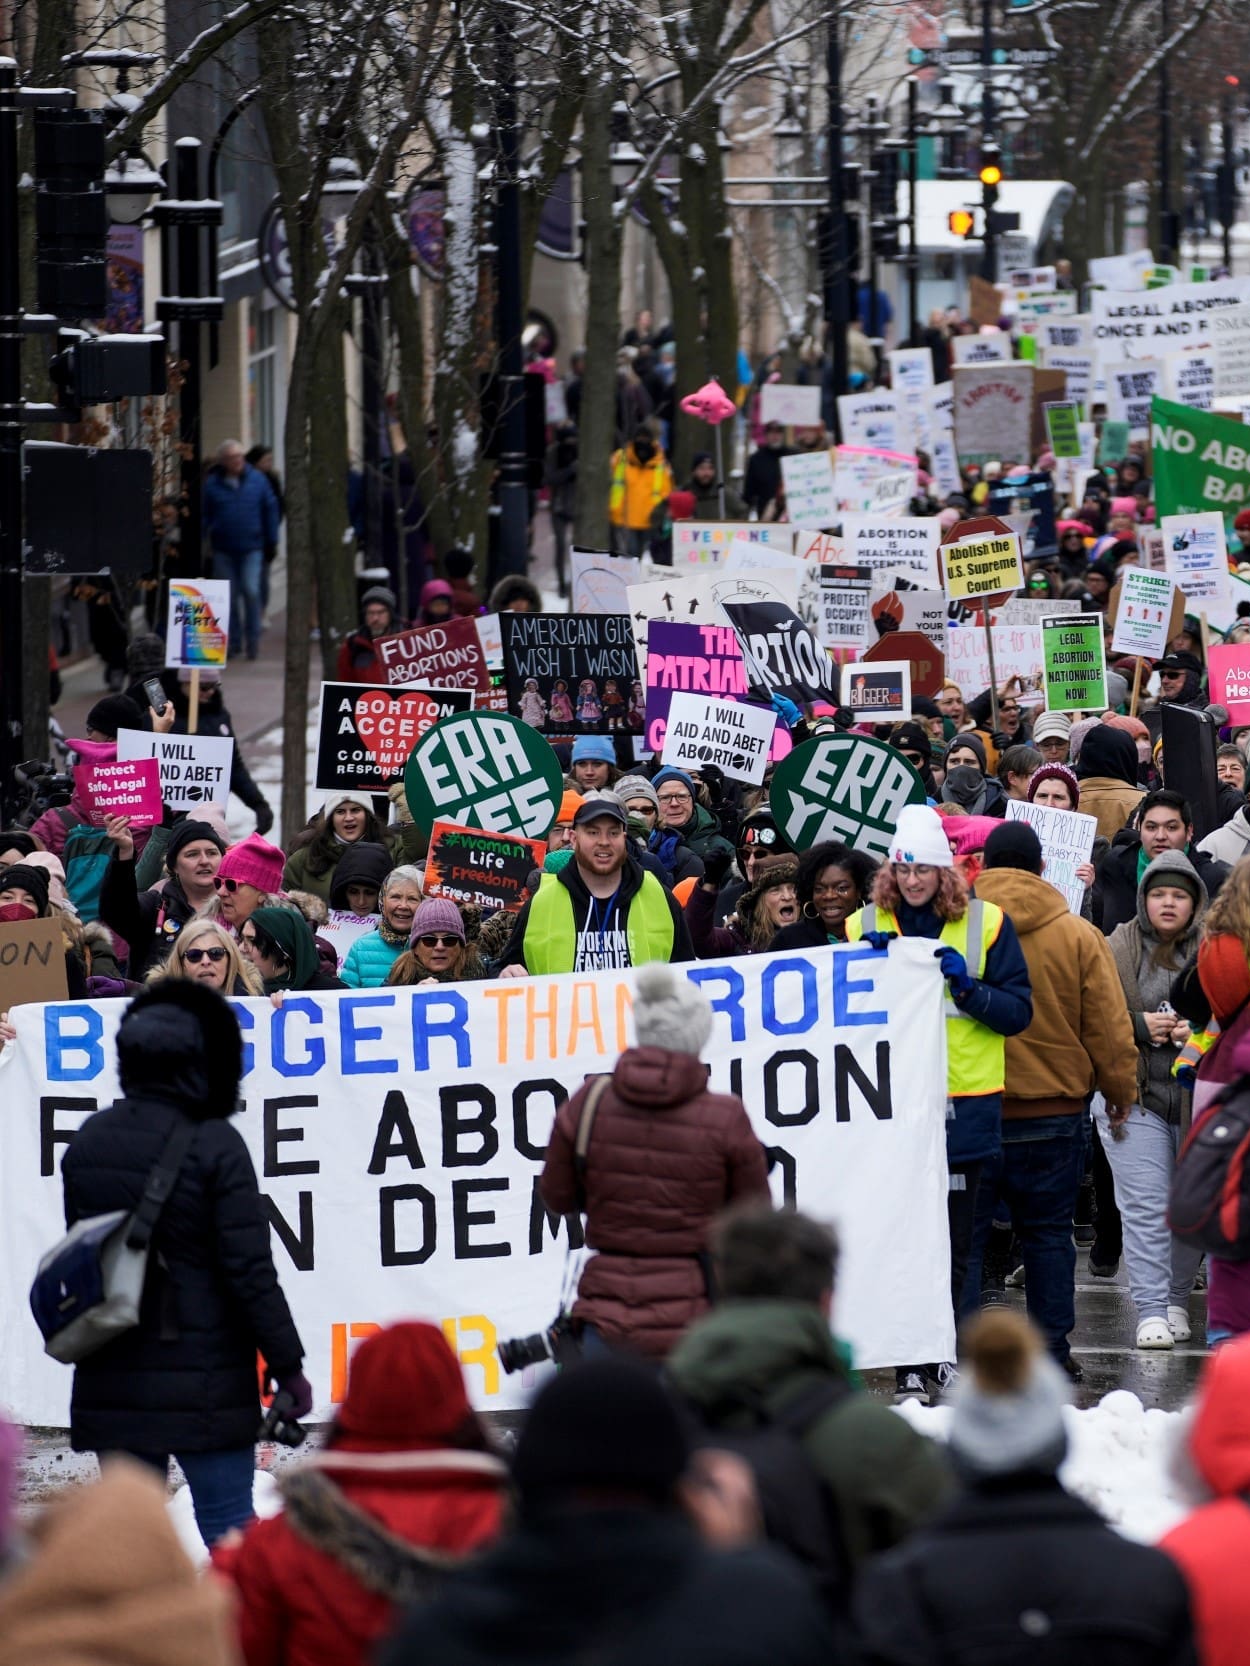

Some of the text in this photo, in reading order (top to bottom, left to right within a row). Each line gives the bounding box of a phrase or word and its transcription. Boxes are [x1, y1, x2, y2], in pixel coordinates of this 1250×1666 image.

[1107, 304, 1163, 318] LEGAL
[1095, 321, 1192, 338] ONCE AND
[1152, 423, 1196, 454] NO
[680, 530, 769, 543] EVERYONE
[857, 529, 928, 539] ABORTION
[857, 549, 929, 558] HEALTHCARE,
[949, 540, 1010, 563] Abolish the
[947, 556, 1018, 579] U.S. Supreme
[737, 579, 769, 599] Power
[966, 576, 1002, 594] Court!
[1128, 573, 1171, 588] STRIKE!
[823, 592, 866, 605] PROTEST
[1140, 586, 1170, 595] ABORTION
[174, 603, 205, 614] NEW
[825, 608, 869, 621] OCCUPY!
[922, 611, 943, 619] NOT
[174, 616, 221, 627] PARTY
[827, 622, 865, 635] STRIKE!
[916, 622, 943, 630] YOUR
[510, 617, 597, 646] AMERICAN
[1059, 632, 1085, 645] LEGAL
[381, 628, 448, 664] FUND
[387, 644, 479, 685] ABORTIONS
[512, 648, 637, 677] WISH I WASN
[1052, 651, 1094, 664] ABORTION
[432, 667, 479, 688] COPS
[1048, 669, 1102, 683] NATIONWIDE
[1065, 688, 1087, 700] NOW!
[338, 698, 455, 718] ABORTION
[705, 706, 746, 729] I WILL
[338, 717, 432, 737] ACCES
[380, 739, 407, 750] IS A
[673, 721, 700, 738] AID
[701, 725, 731, 744] AND
[732, 732, 765, 753] ABET
[152, 742, 196, 761] I WILL
[416, 716, 533, 807] ERA
[93, 764, 136, 777] Protect
[184, 766, 223, 782] ABET
[88, 776, 146, 793] Safe, Legal
[801, 738, 915, 826] ERA
[94, 792, 142, 807] Abortion
[1011, 802, 1052, 841] YOU'RE
[469, 851, 505, 869] Life
[1048, 847, 1083, 862] BABY IS
[452, 867, 519, 890] Freedom
[429, 884, 505, 909] #Free Iran
[333, 910, 376, 925] Freedom
[577, 930, 635, 953] WORKING
[687, 949, 889, 1043] ROE
